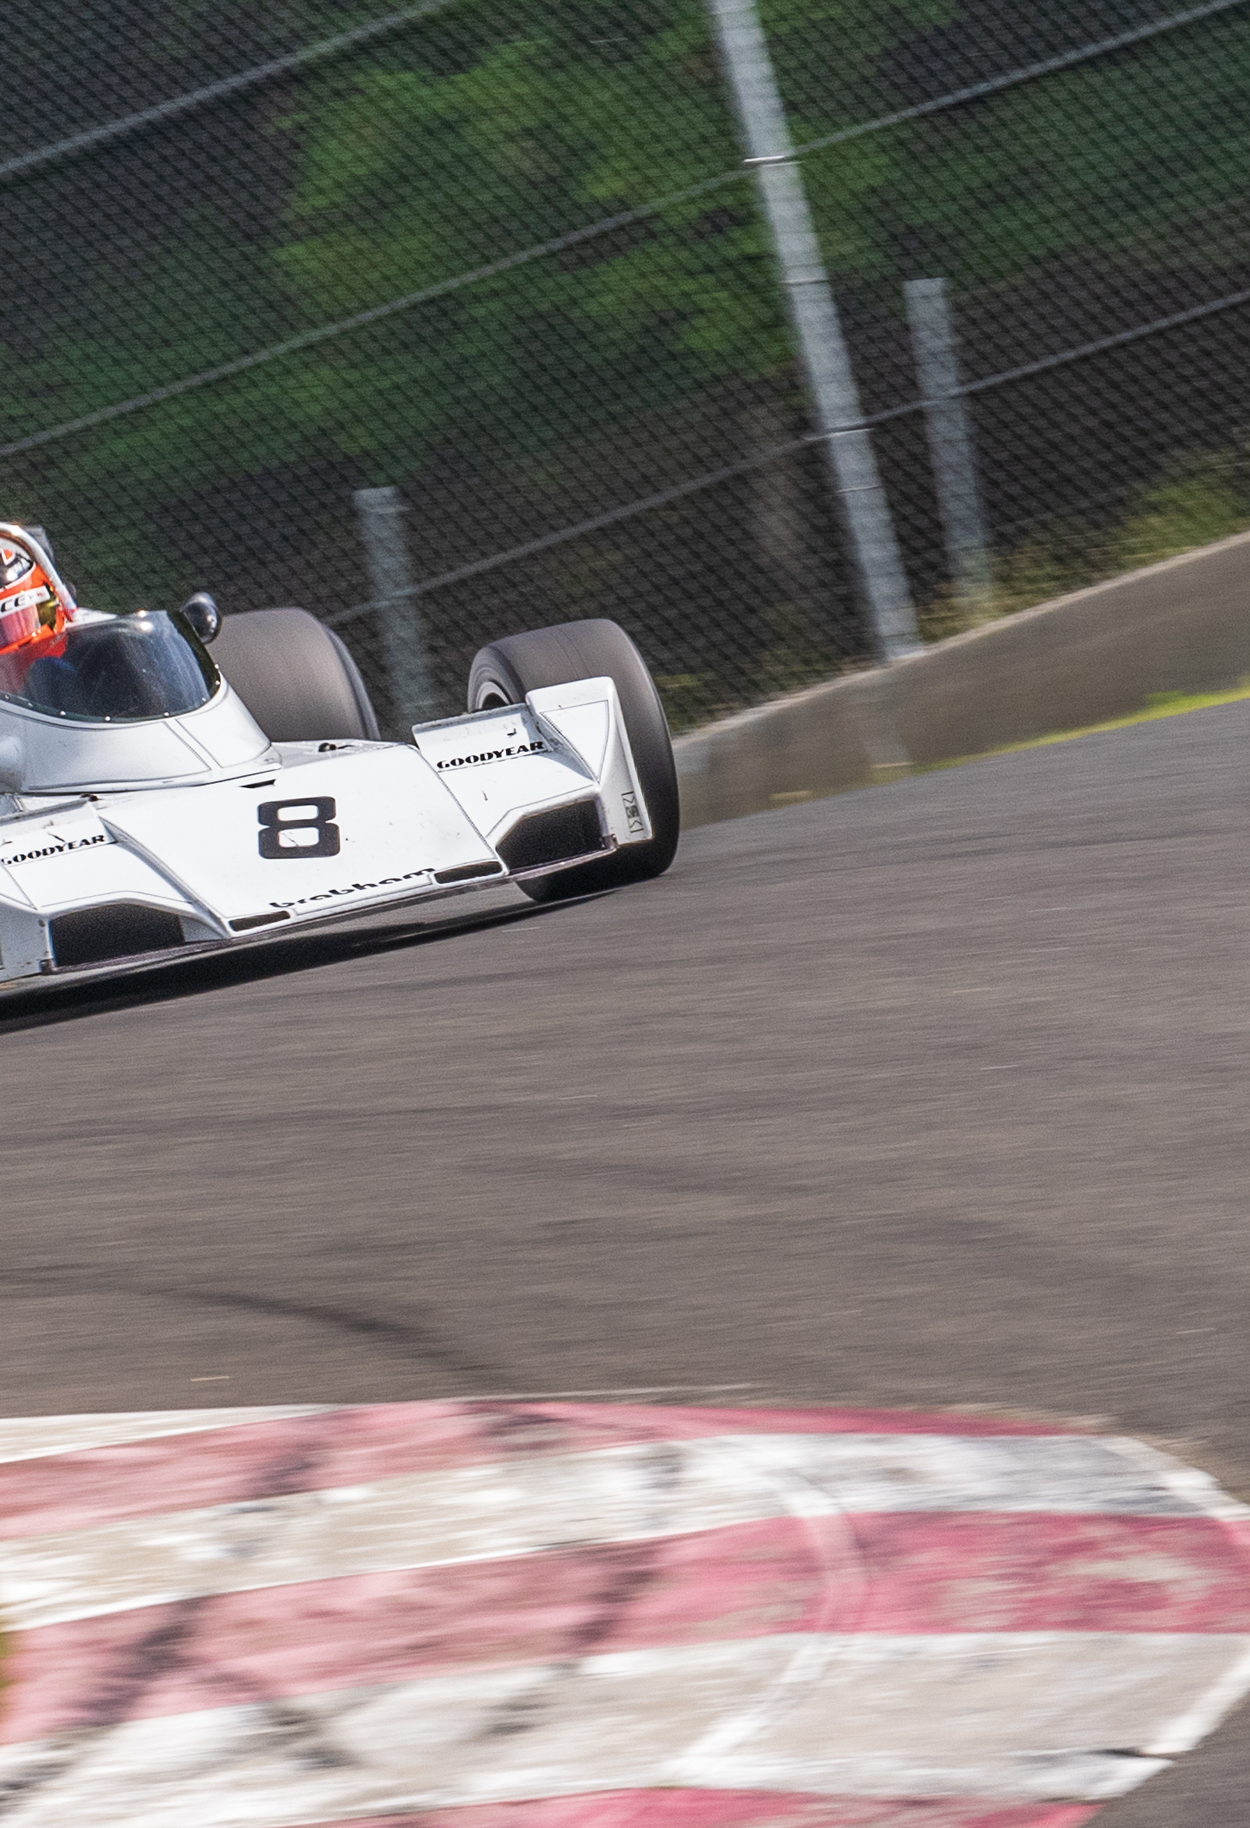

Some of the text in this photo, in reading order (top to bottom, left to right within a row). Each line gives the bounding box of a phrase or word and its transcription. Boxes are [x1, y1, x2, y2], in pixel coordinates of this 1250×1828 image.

[436, 741, 545, 769] GOODYEAR
[257, 796, 341, 859] 8
[1, 834, 105, 866] GOODYEAR
[269, 867, 436, 908] brabham
